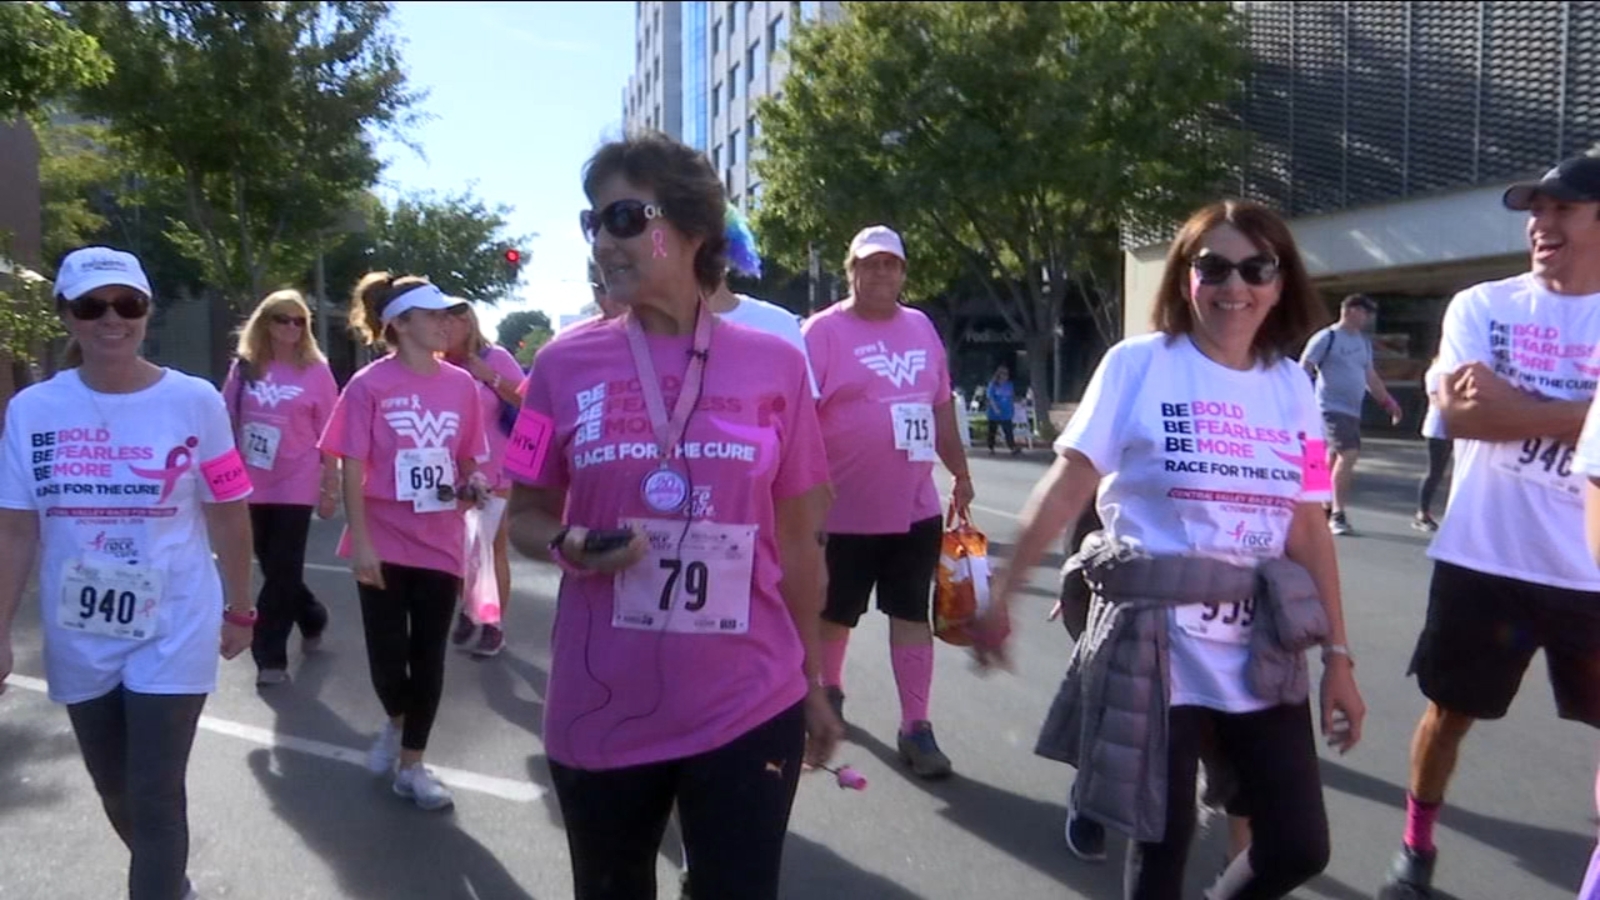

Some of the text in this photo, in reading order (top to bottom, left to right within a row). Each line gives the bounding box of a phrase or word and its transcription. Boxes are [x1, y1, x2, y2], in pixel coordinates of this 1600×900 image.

[1513, 324, 1558, 339] BOLD
[1539, 376, 1563, 388] THE
[575, 375, 679, 411] BE BOD
[607, 396, 742, 413] FEESS
[1161, 400, 1244, 420] BE BOLD
[31, 428, 110, 448] BE BOLD
[574, 421, 601, 446] BE
[904, 419, 929, 440] 715
[1163, 420, 1291, 444] BE FEARLESS
[32, 445, 154, 464] BE FEARLESS
[574, 442, 756, 470] RACE FOR HE CURE
[1165, 437, 1255, 458] BE MORE
[33, 462, 112, 481] BE MORE
[410, 466, 444, 490] 692
[1165, 460, 1301, 483] RACE FOR THE CUR
[63, 483, 93, 495] FOR
[95, 484, 122, 495] THE
[124, 484, 160, 495] CURE
[659, 559, 708, 612] 79
[80, 585, 136, 624] 940
